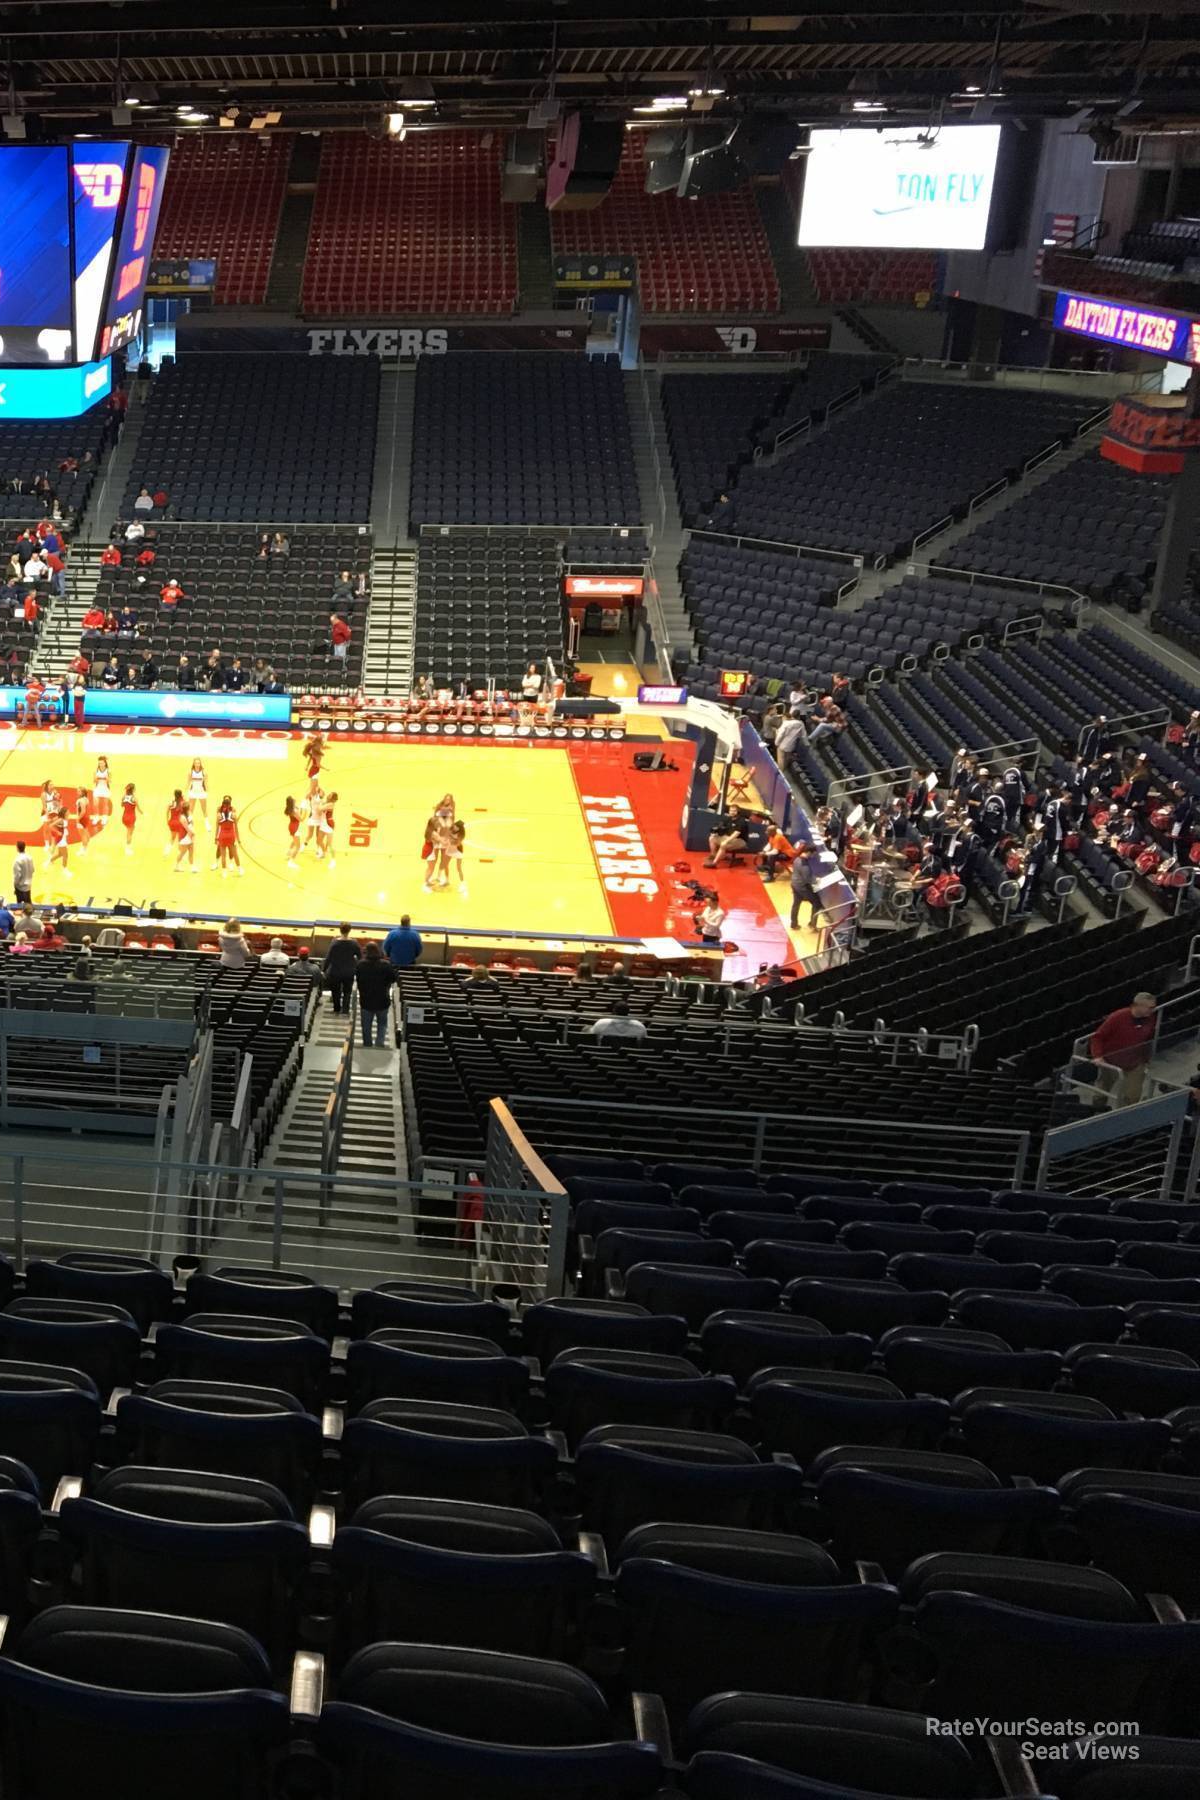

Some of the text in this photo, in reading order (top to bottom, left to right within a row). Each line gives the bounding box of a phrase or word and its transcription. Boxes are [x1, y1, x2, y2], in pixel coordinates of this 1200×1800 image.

[307, 329, 448, 356] FLYERS
[1064, 299, 1177, 351] DAYTON FLYERS
[125, 725, 329, 742] DAYTON
[582, 795, 659, 894] FLYERS
